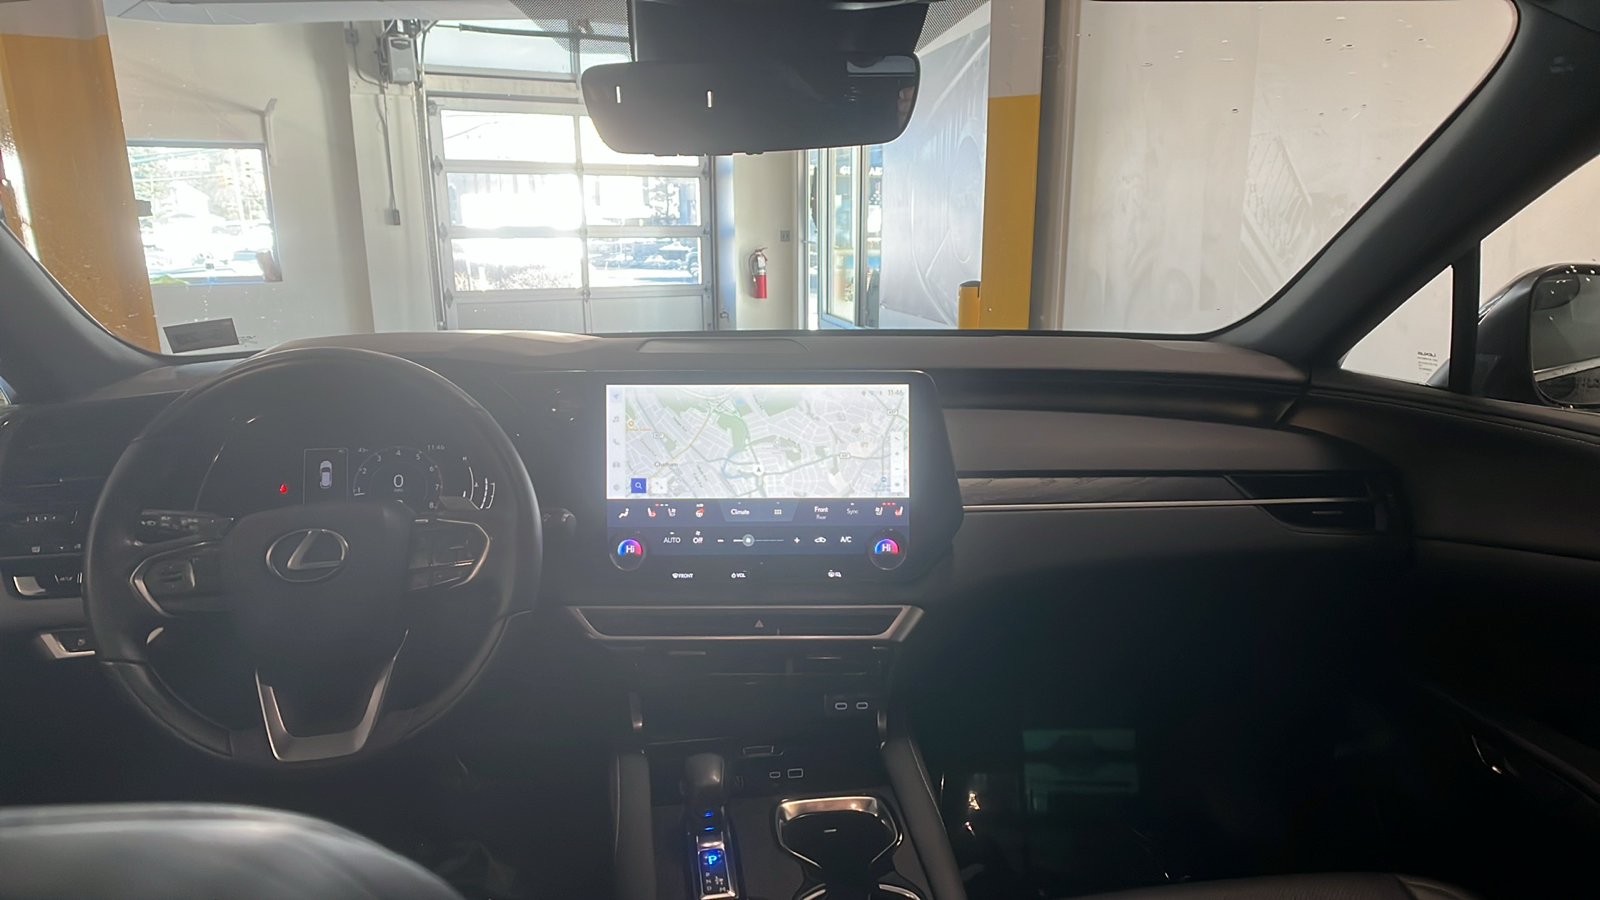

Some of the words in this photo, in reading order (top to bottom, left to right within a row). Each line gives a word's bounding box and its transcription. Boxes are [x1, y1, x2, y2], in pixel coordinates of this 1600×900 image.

[415, 453, 421, 461] 5
[362, 467, 367, 475] 2
[393, 474, 404, 488] 0
[428, 501, 434, 509] 8
[663, 536, 681, 544] AUTO
[692, 536, 704, 544] Off
[625, 544, 635, 554] Hi
[881, 543, 891, 552] Hi
[708, 855, 717, 865] P
